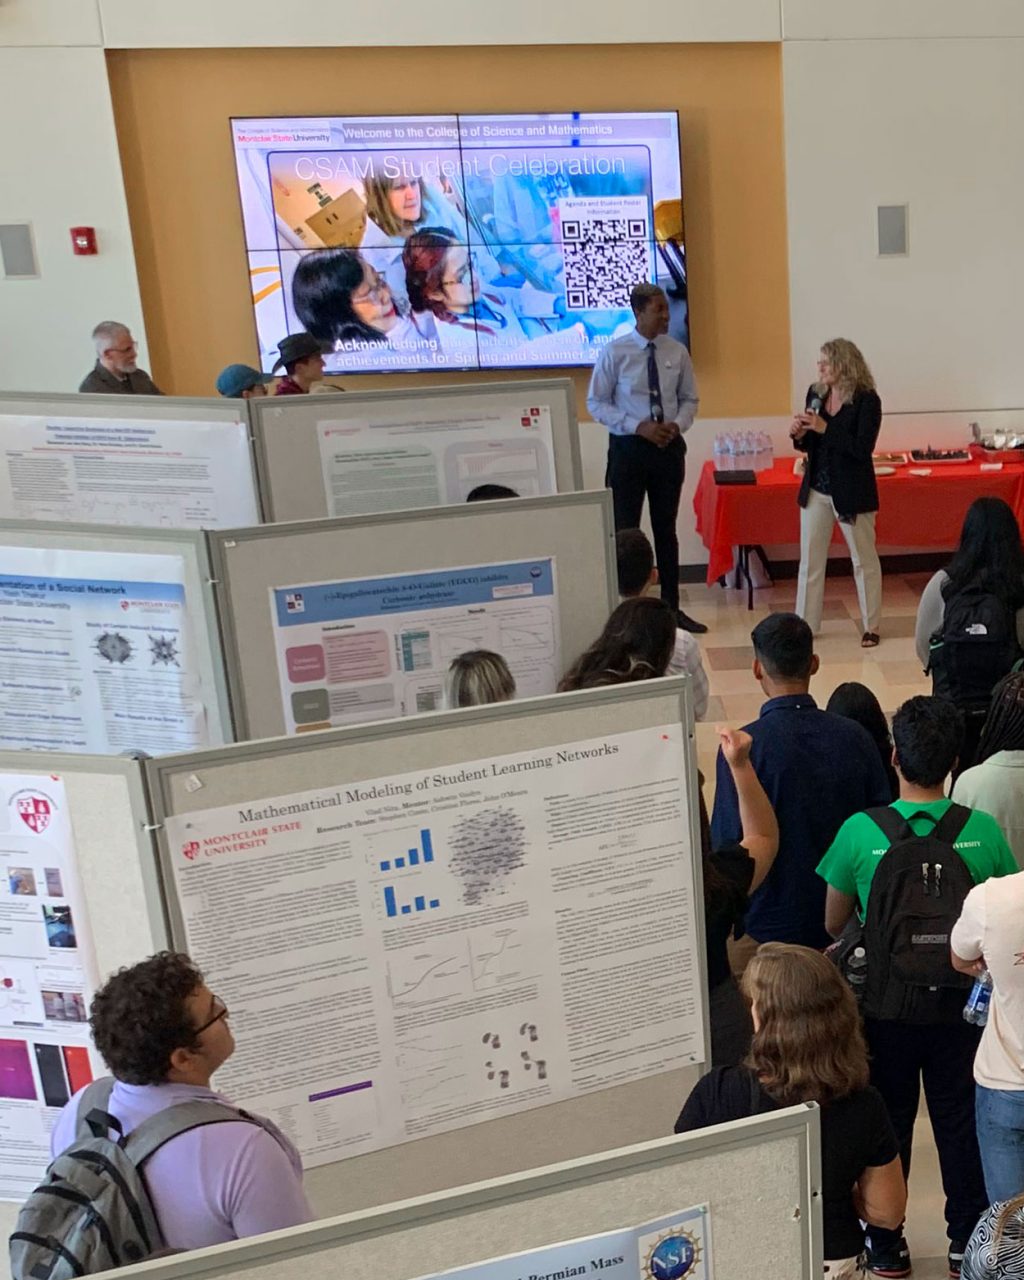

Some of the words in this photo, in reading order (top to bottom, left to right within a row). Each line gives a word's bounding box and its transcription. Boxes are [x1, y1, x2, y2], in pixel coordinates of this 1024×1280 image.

[343, 127, 392, 139] Welcome
[394, 128, 404, 137] to
[407, 127, 424, 137] the
[427, 126, 469, 139] College
[470, 126, 480, 136] of
[483, 125, 524, 136] Science
[526, 125, 546, 136] and
[548, 124, 613, 136] Mathematics
[295, 156, 375, 180] CSAM
[383, 154, 481, 179] Student
[489, 153, 626, 178] Celebration
[334, 338, 438, 352] Acknowledging
[336, 353, 431, 367] achievements
[432, 352, 449, 364] for
[455, 351, 498, 365] Spring
[530, 349, 583, 361] Summer
[37, 582, 47, 591] of
[56, 583, 85, 593] Social
[87, 585, 127, 595] Network
[239, 792, 342, 823] Mathematical
[346, 782, 412, 803] Modeling
[416, 773, 430, 789] of
[434, 765, 487, 787] Student
[492, 756, 552, 775] Learning
[556, 742, 619, 764] Networks
[203, 827, 269, 846] MONTCLAIR
[272, 820, 302, 834] STATE
[205, 837, 267, 857] UNIVERSITY
[590, 1253, 624, 1271] Mass
[650, 1243, 695, 1275] NSF
